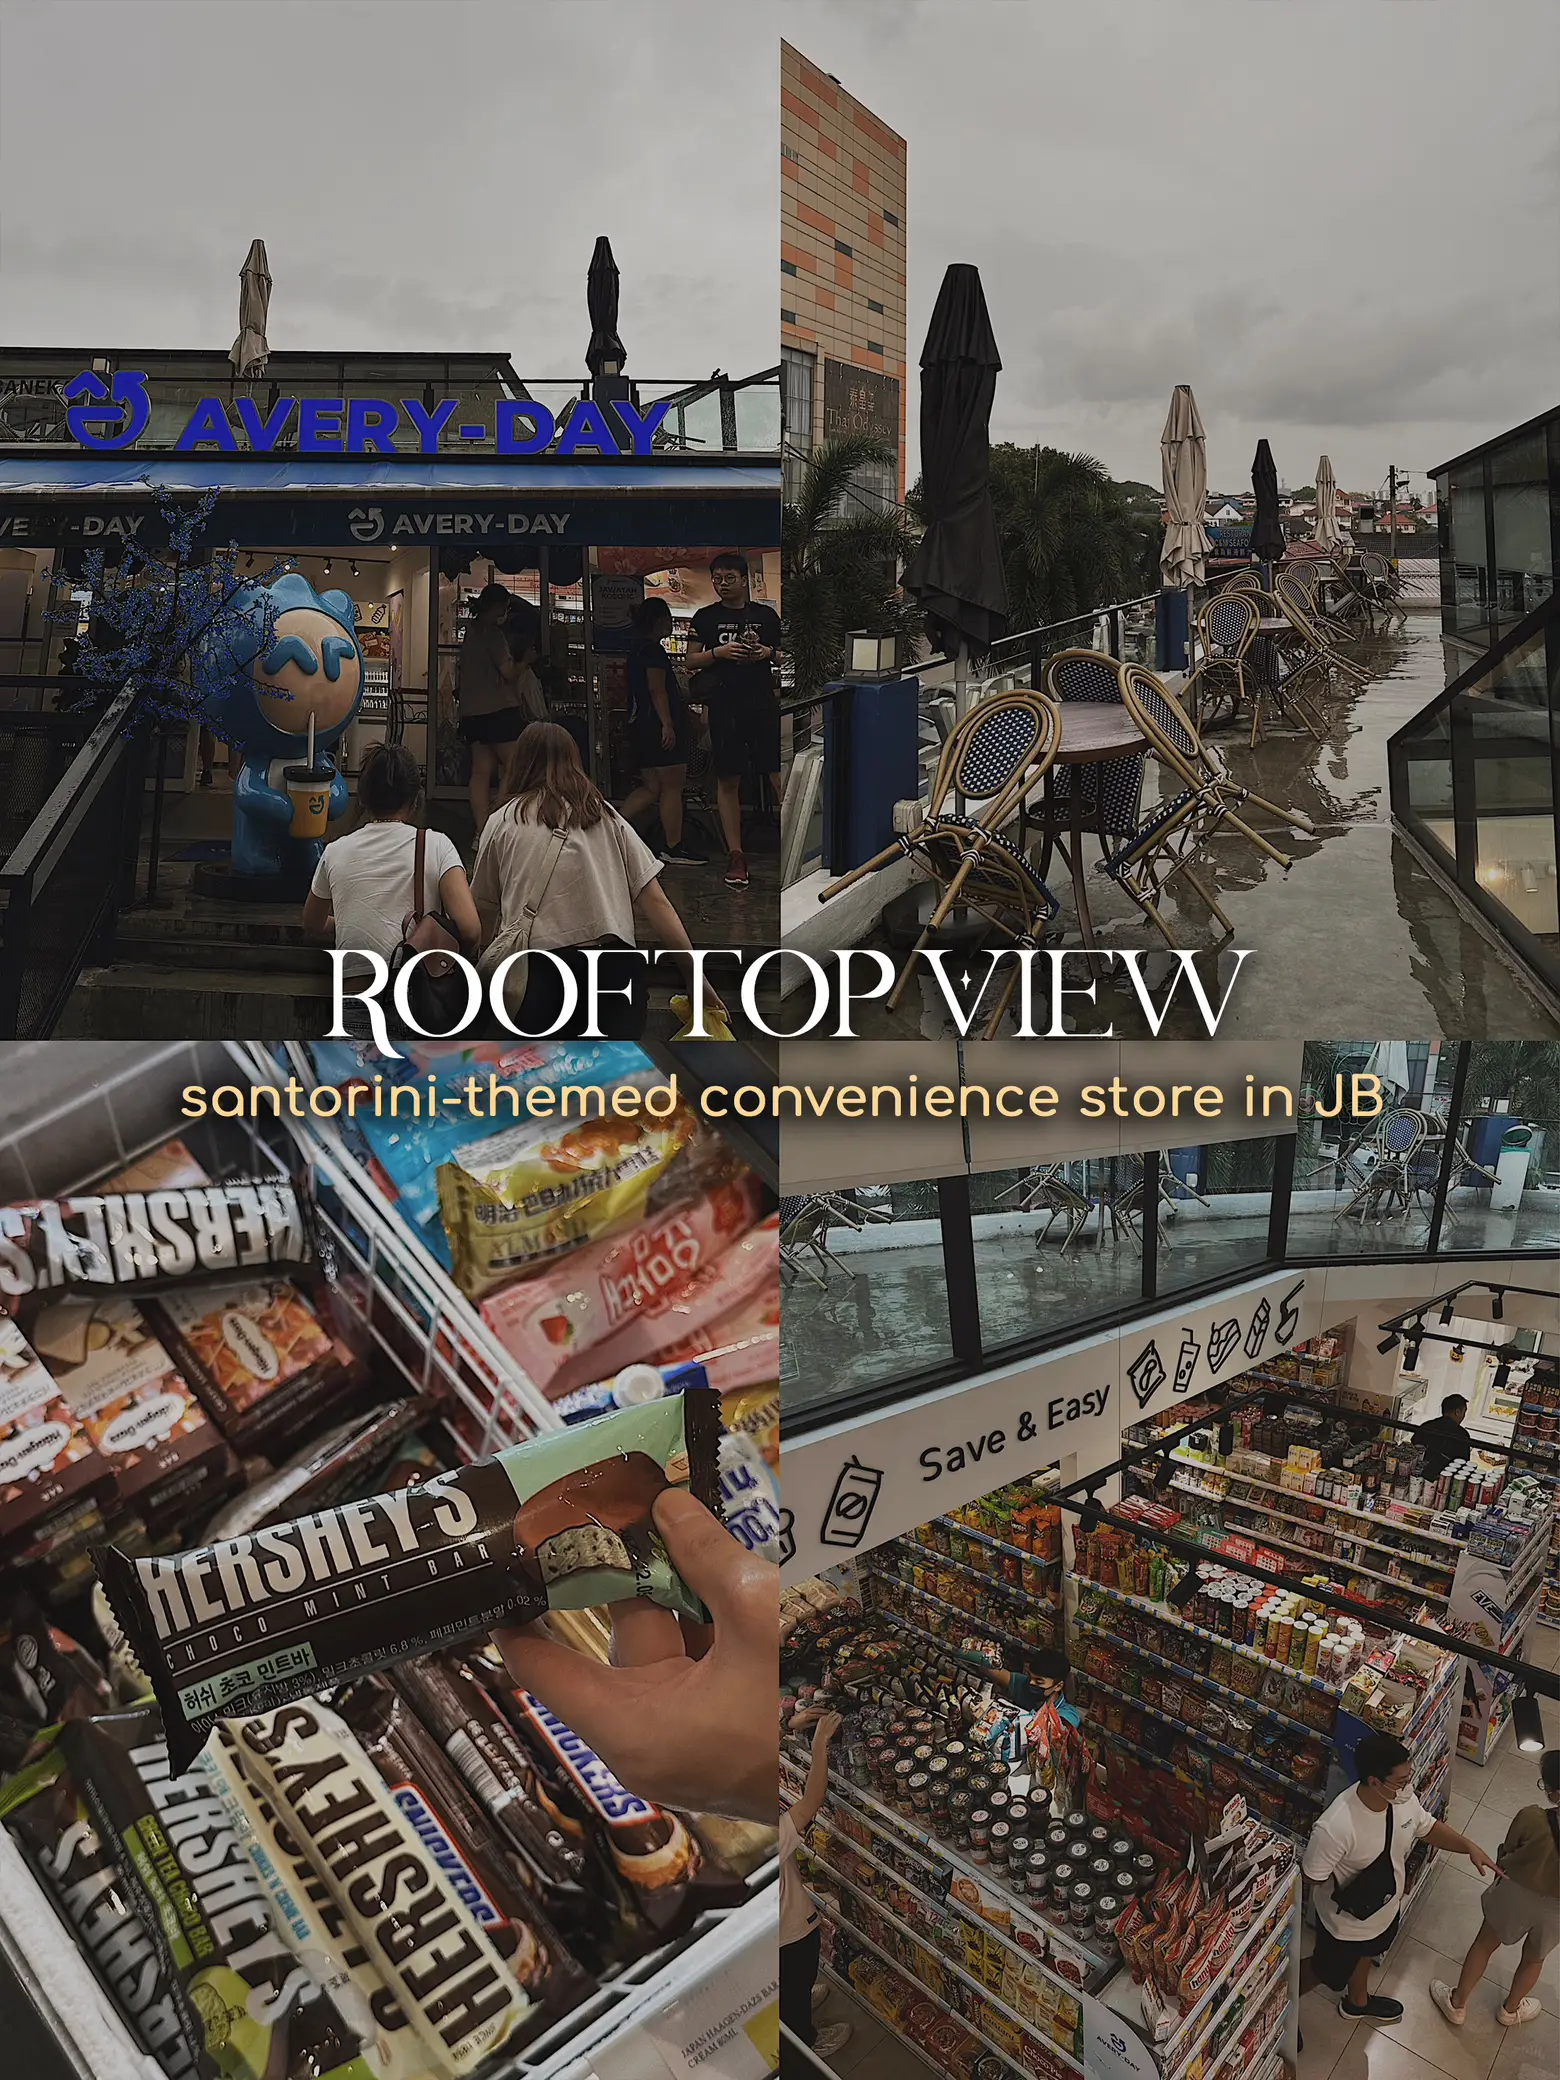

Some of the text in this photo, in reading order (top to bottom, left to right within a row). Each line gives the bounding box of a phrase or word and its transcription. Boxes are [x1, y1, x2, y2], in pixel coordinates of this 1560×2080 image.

[178, 399, 674, 456] AVERY-DAY
[392, 512, 571, 536] AVERY-DAY
[918, 1381, 1111, 1483] Save & Easy
[165, 1542, 491, 1671] CHOCO MINT BAR
[388, 1638, 410, 1657] 6.8
[505, 1593, 534, 1612] 0.02
[534, 1594, 547, 1608] %
[1473, 1591, 1497, 1613] EVE
[183, 1683, 217, 1712] 허쉬
[219, 1668, 257, 1697] 초코
[259, 1648, 314, 1685] 민트바
[155, 1853, 184, 1883] TEA
[184, 1922, 220, 1960] BAR
[241, 1705, 513, 2049] HERSHEY'S
[679, 2034, 708, 2060] JAPAN
[704, 1991, 763, 2041] HAAGEN-DAZS
[686, 2041, 719, 2070] CREAM
[1096, 2035, 1141, 2073] AVERY-DAY
